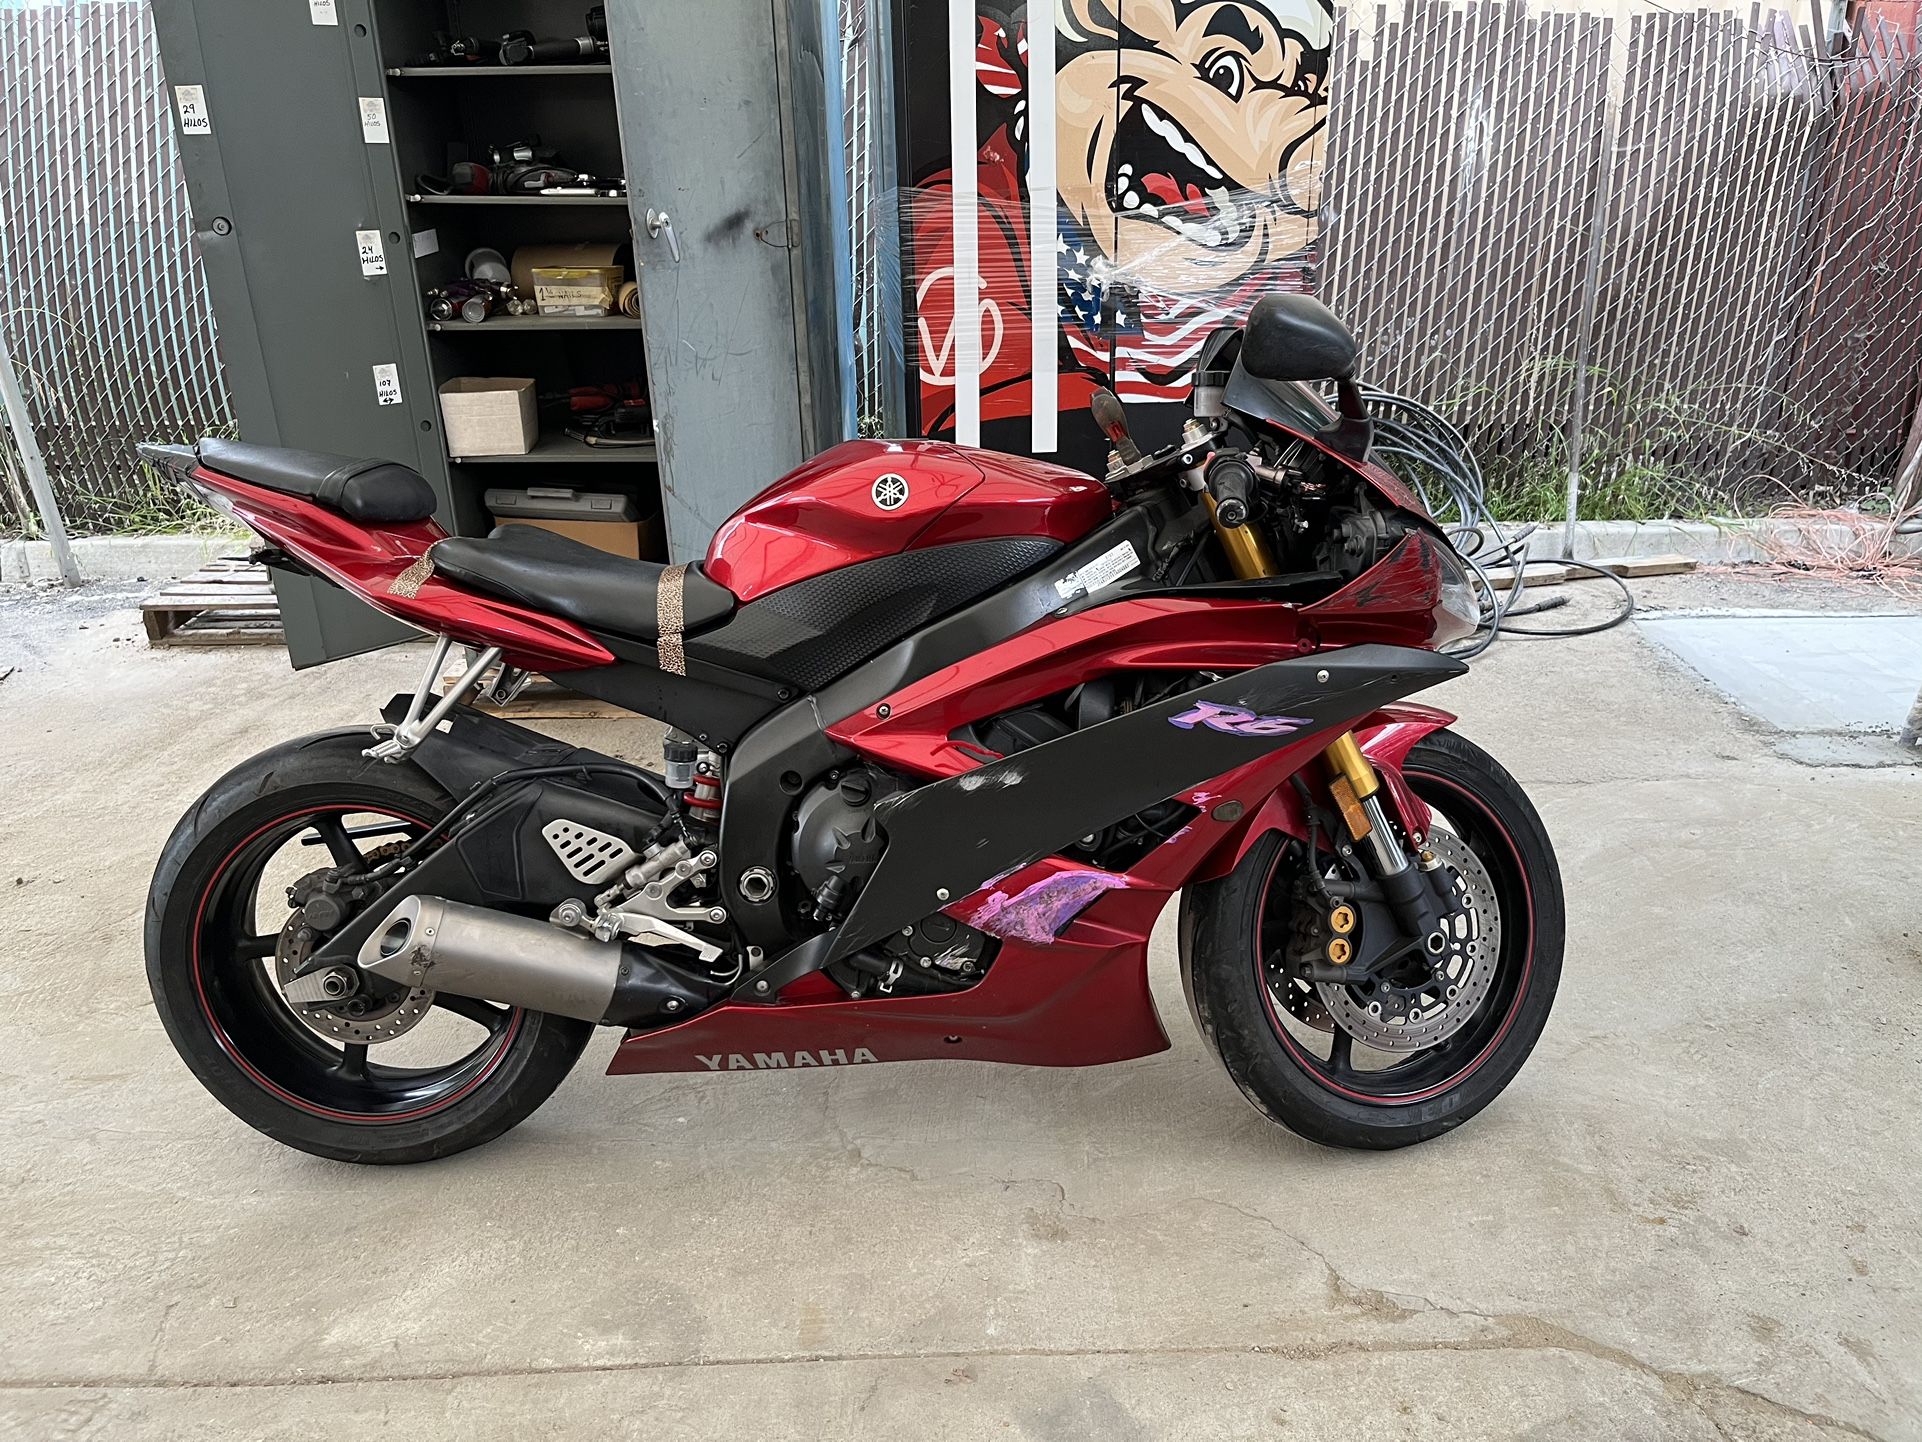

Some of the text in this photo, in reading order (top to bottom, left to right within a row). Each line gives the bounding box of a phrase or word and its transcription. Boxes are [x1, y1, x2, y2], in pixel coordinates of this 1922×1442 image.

[182, 103, 196, 114] 29
[183, 117, 208, 128] HILOS
[361, 245, 374, 255] 24
[379, 379, 391, 387] 107
[379, 388, 398, 398] HILOS
[1167, 699, 1315, 737] R6
[694, 1047, 879, 1071] YAMAHA
